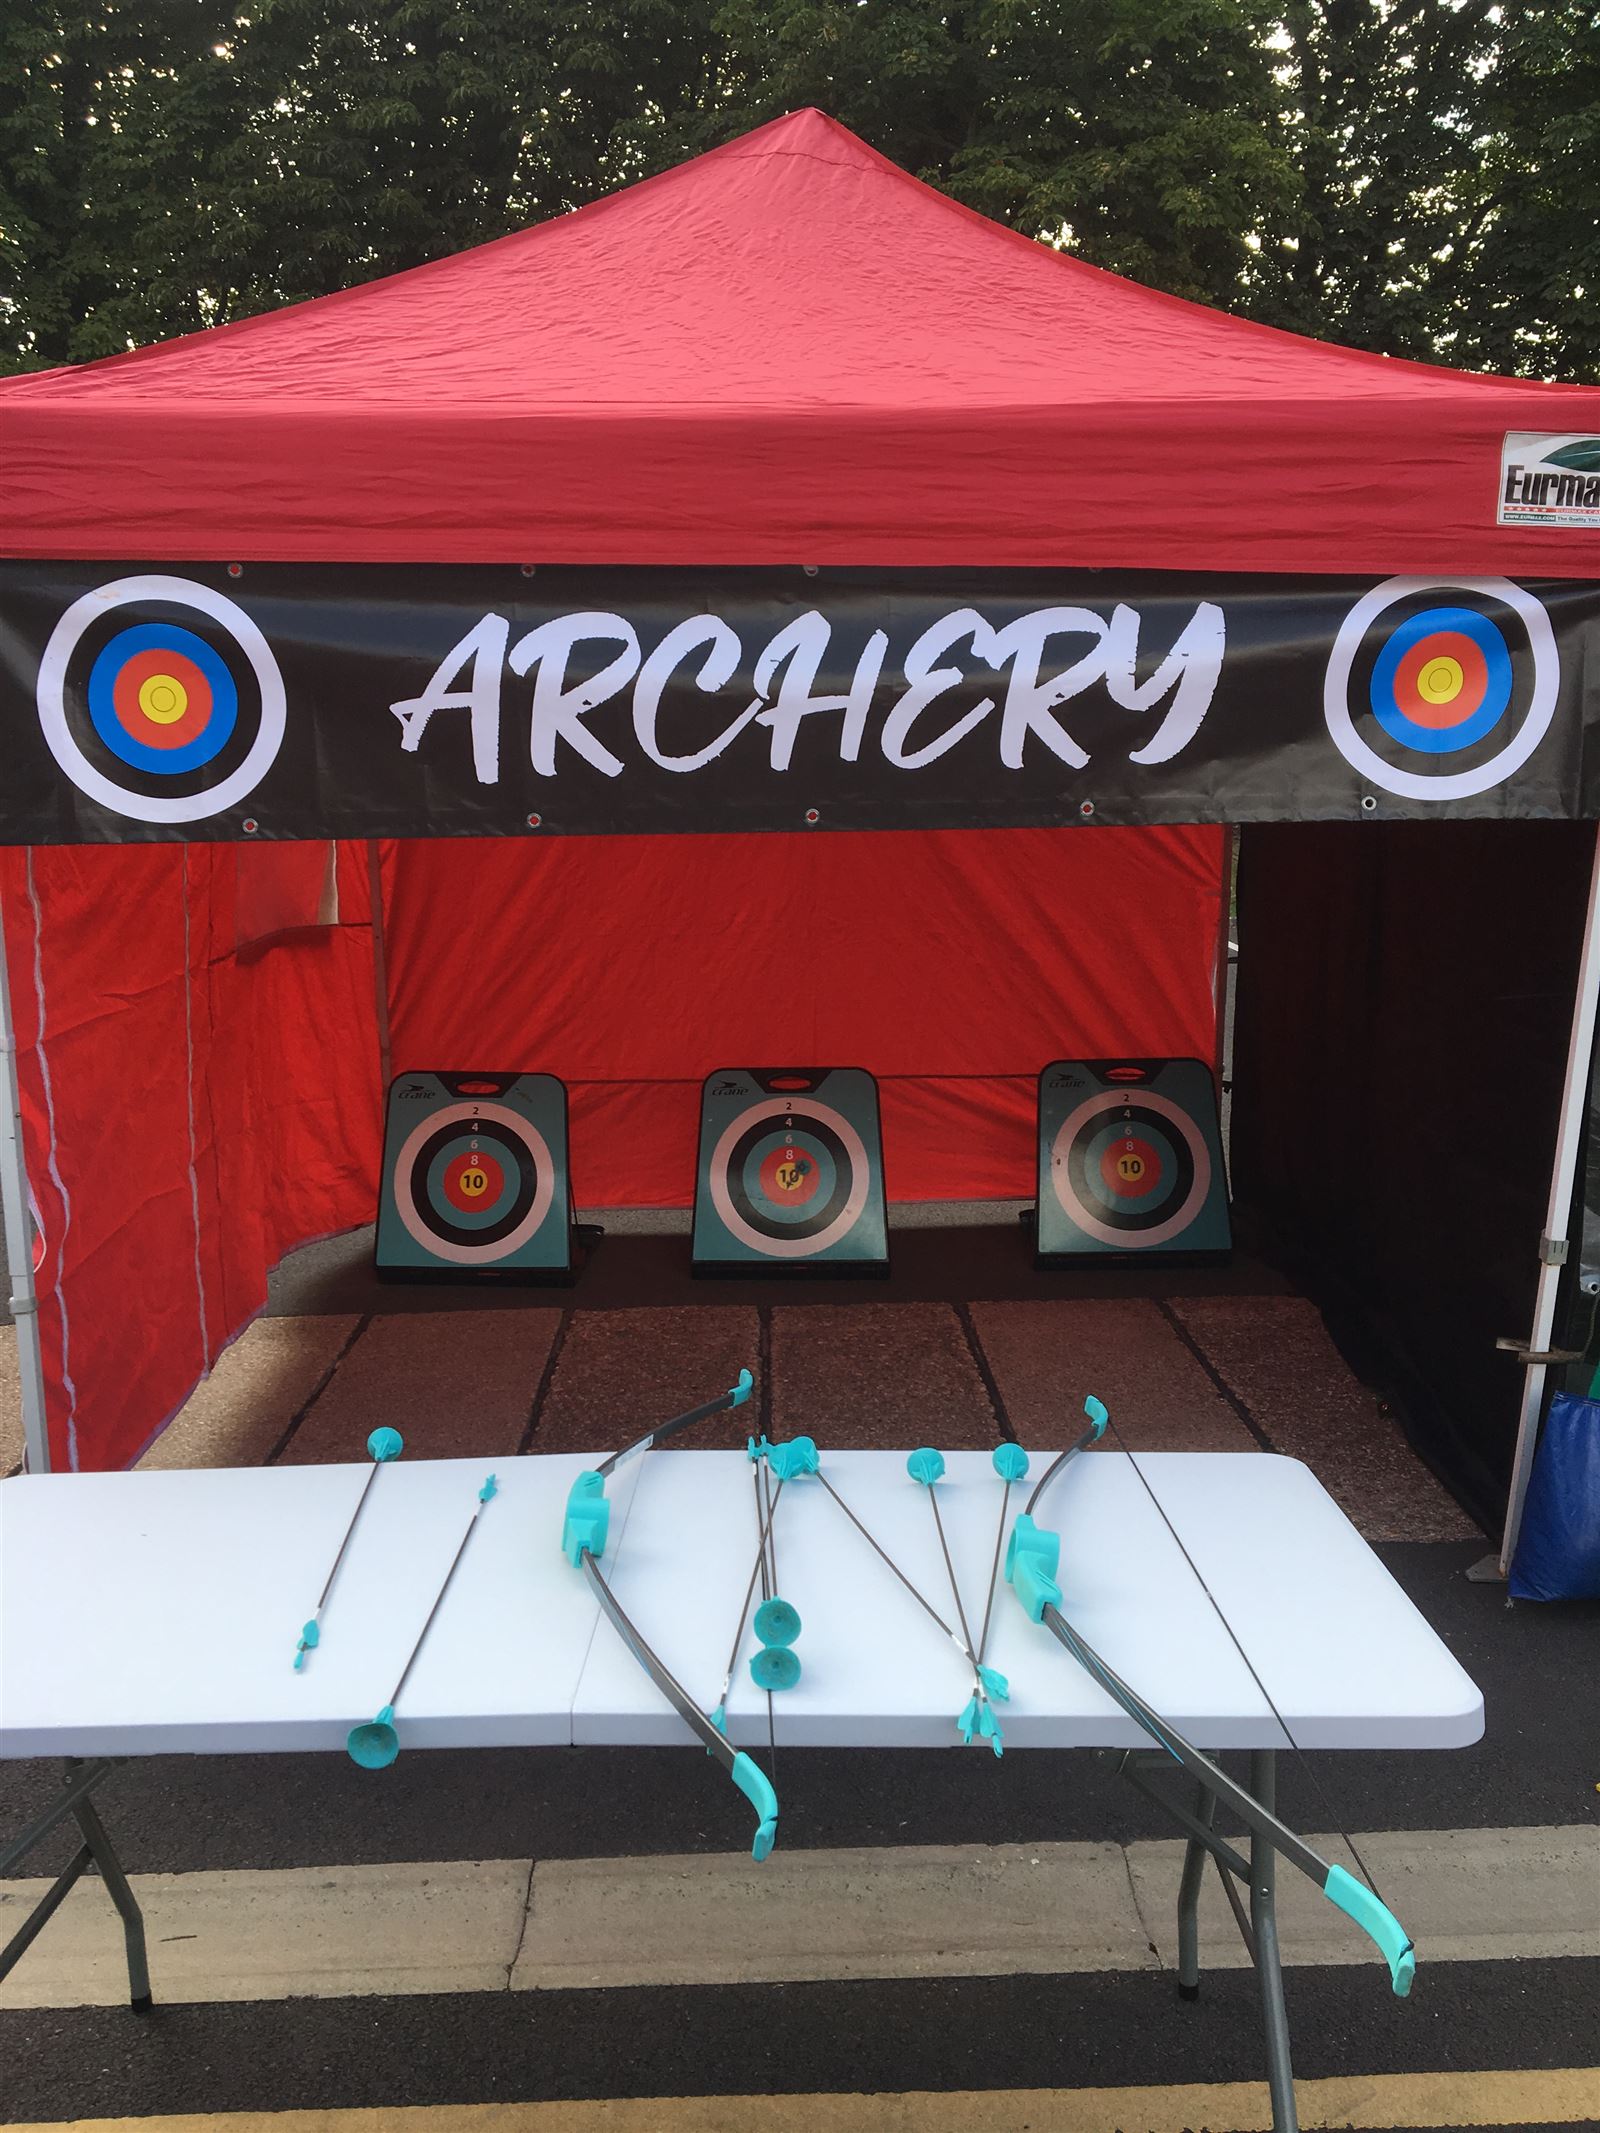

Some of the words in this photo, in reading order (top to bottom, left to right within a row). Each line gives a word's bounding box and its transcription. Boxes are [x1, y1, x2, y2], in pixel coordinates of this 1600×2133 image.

[389, 601, 1226, 784] ARCHERY
[1123, 1094, 1129, 1102] 2
[473, 1107, 479, 1115] 2
[786, 1102, 792, 1110] 2
[1124, 1109, 1131, 1118] 4
[472, 1122, 479, 1132] 4
[785, 1118, 792, 1127] 4
[1125, 1126, 1132, 1136] 6
[785, 1135, 792, 1144] 6
[471, 1140, 479, 1150] 6
[1126, 1141, 1134, 1152] 8
[786, 1149, 793, 1160] 8
[471, 1154, 479, 1166] 8
[1121, 1160, 1141, 1174] 10
[780, 1169, 799, 1183] 10
[464, 1175, 484, 1189] 10
